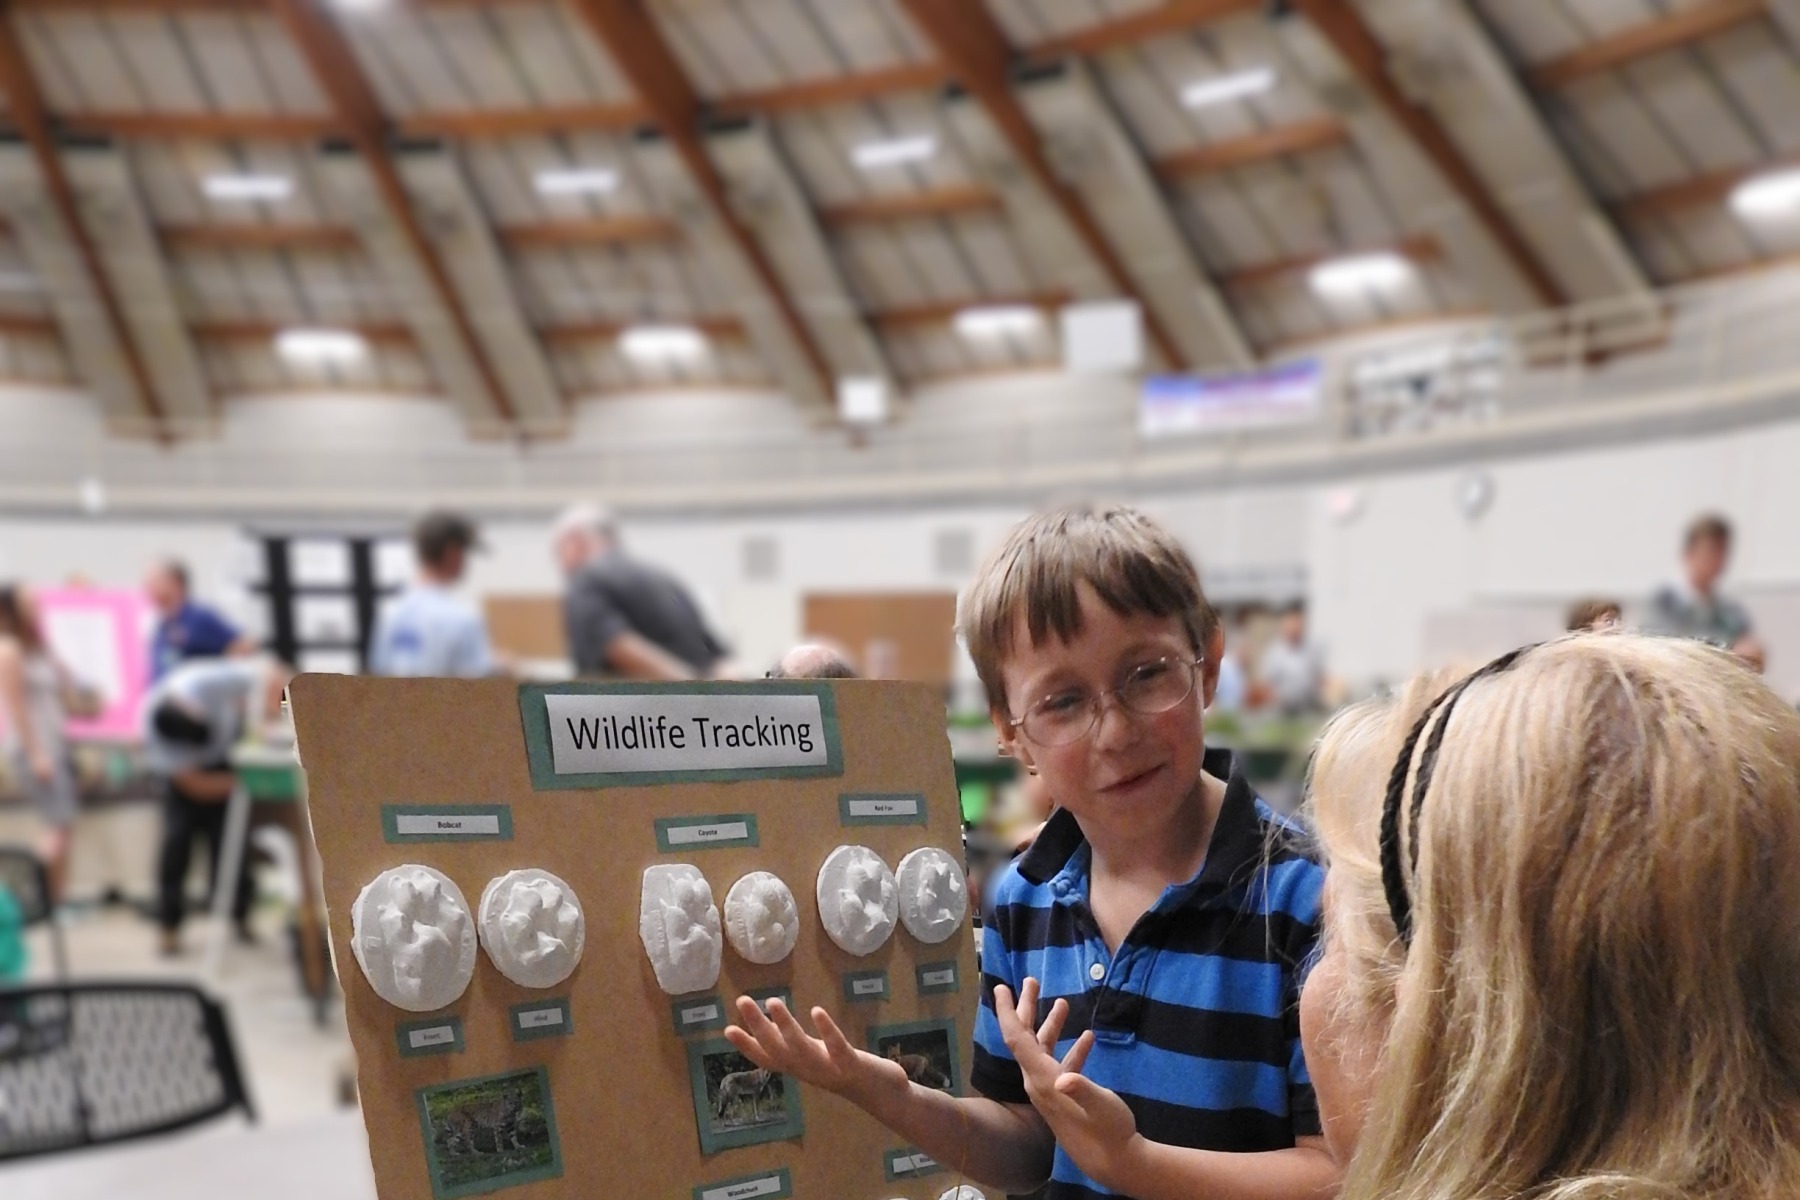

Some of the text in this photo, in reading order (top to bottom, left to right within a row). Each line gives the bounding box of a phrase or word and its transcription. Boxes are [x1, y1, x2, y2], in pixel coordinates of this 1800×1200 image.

[567, 715, 814, 753] Wildlife Tracking
[437, 821, 462, 829] Bobcat
[698, 829, 718, 837] Coyote
[727, 1186, 759, 1198] Woodchuck
